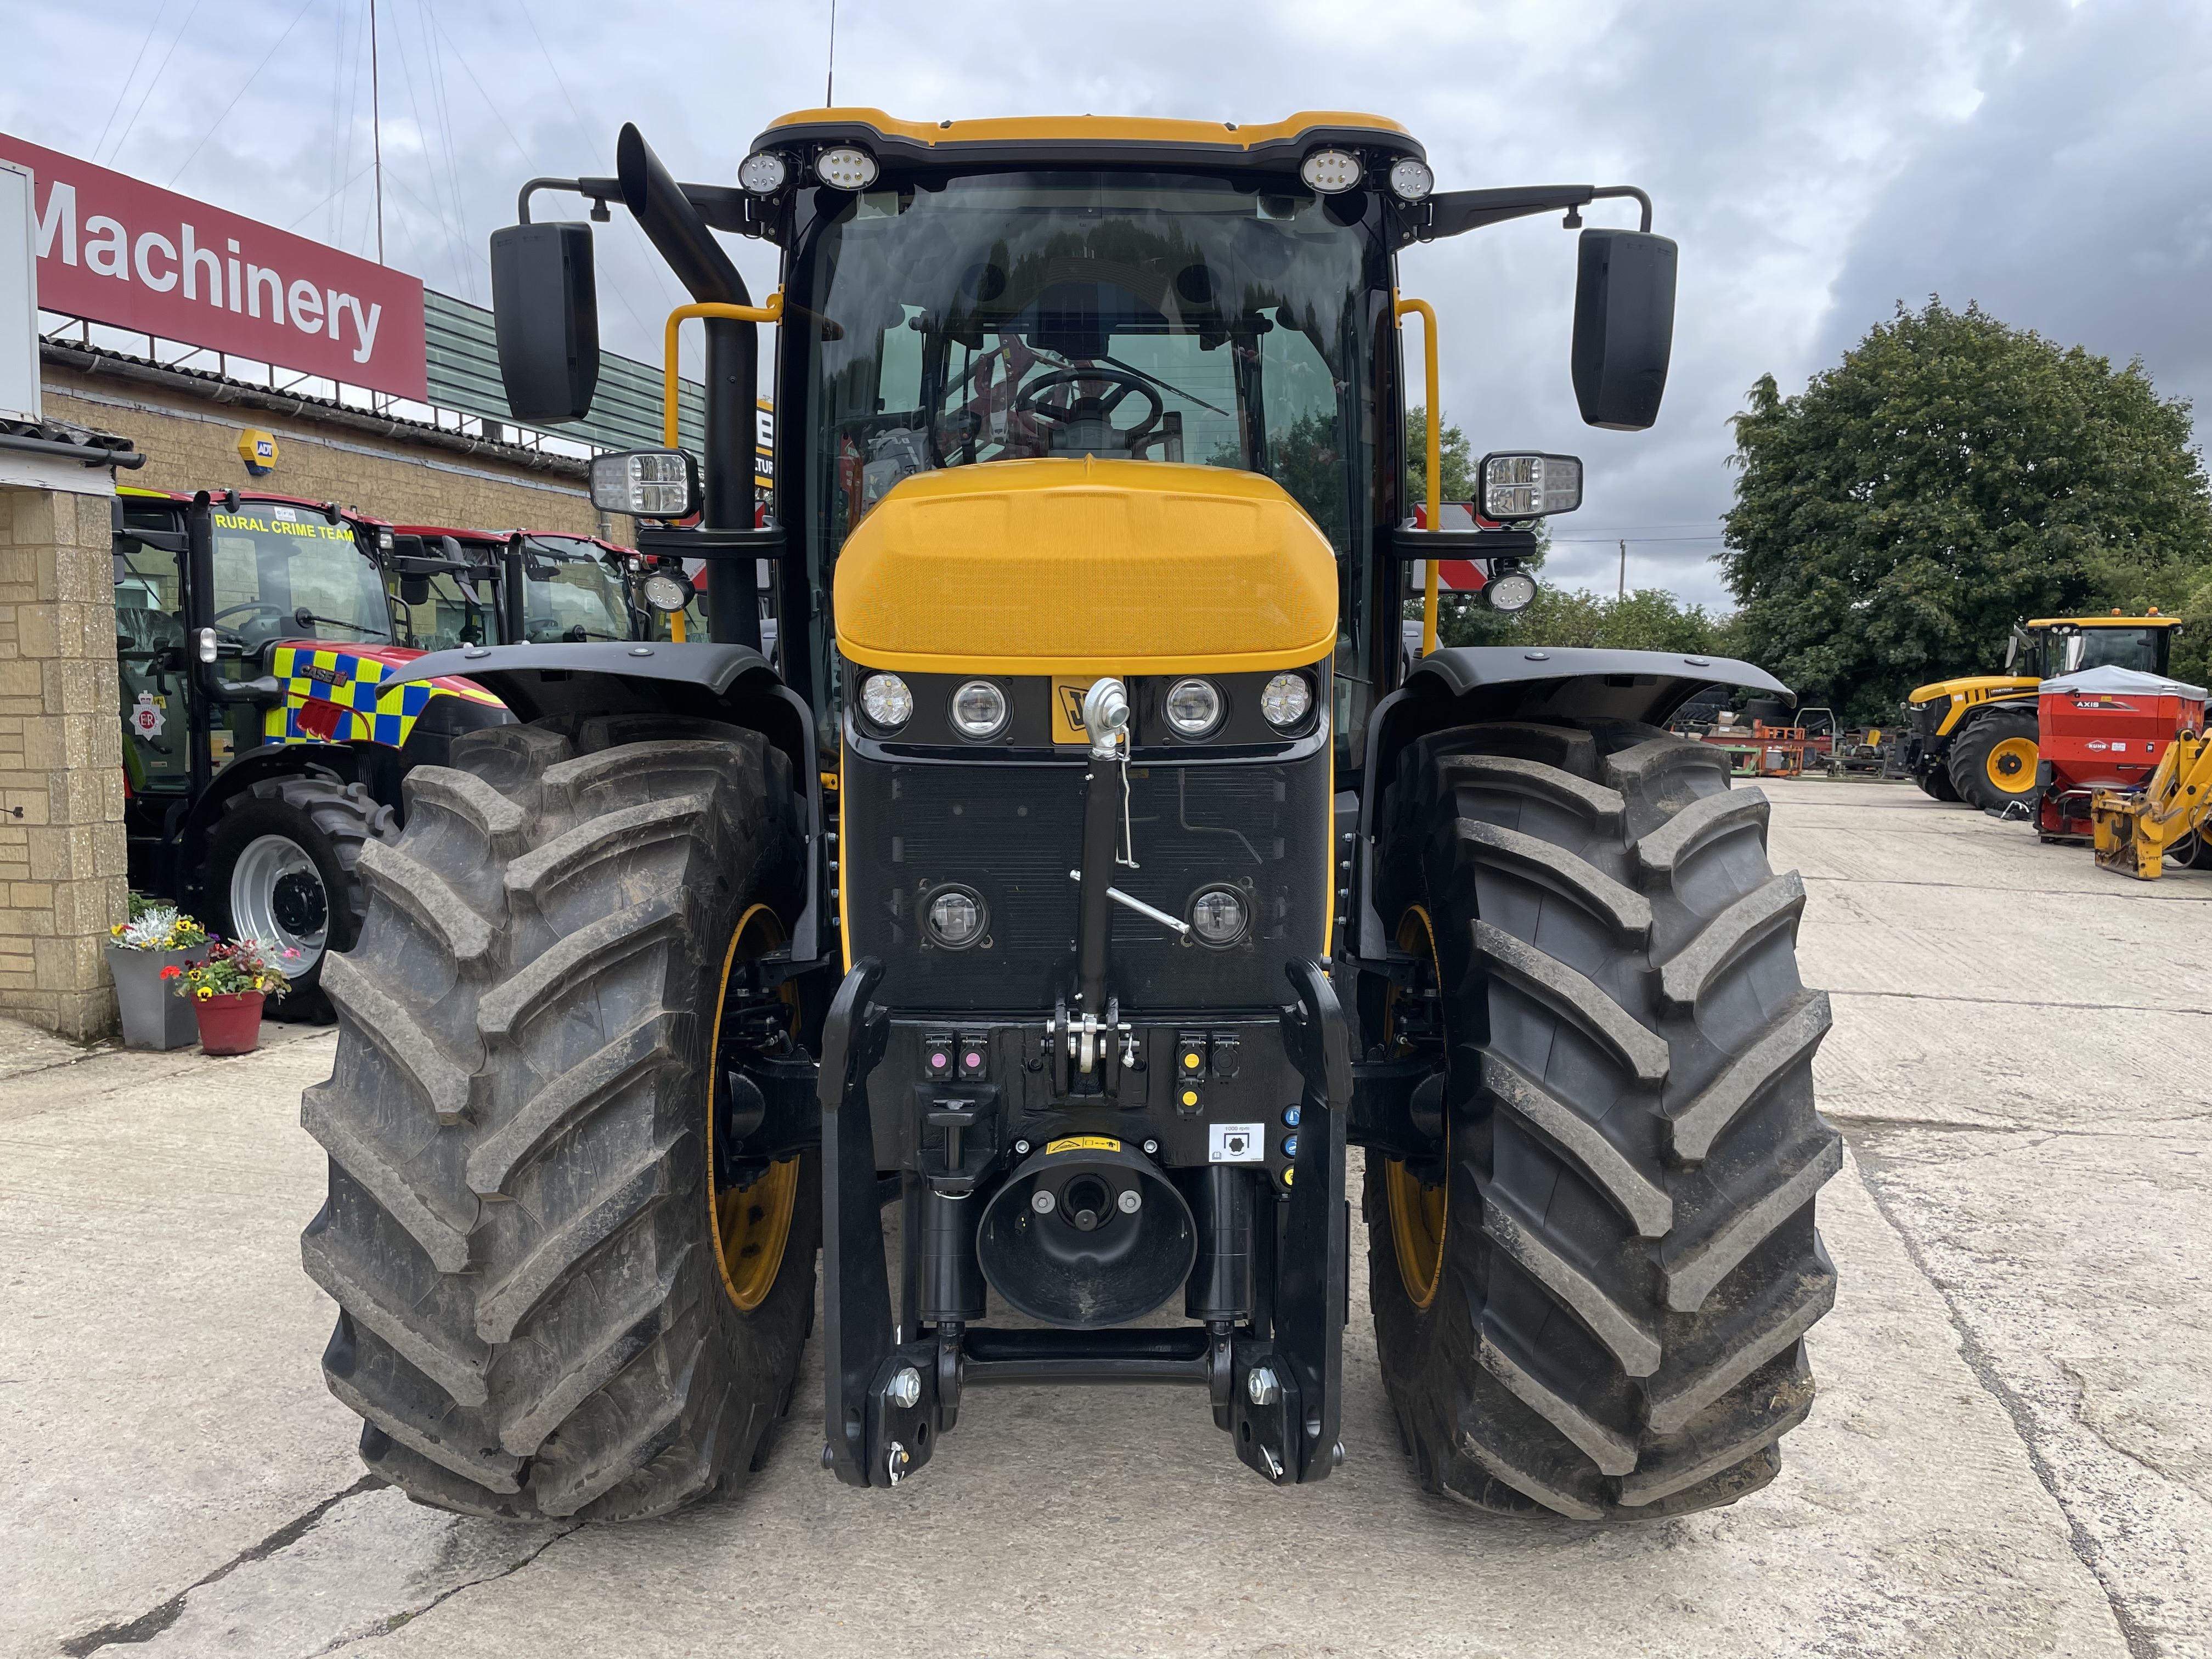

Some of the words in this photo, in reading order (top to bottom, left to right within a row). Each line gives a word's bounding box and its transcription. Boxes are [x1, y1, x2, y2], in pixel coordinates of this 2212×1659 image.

[36, 180, 381, 364] Machinery
[258, 443, 272, 456] ADT
[215, 514, 269, 532] RURAL
[271, 521, 317, 538] CRIME
[317, 526, 355, 542] TEAM
